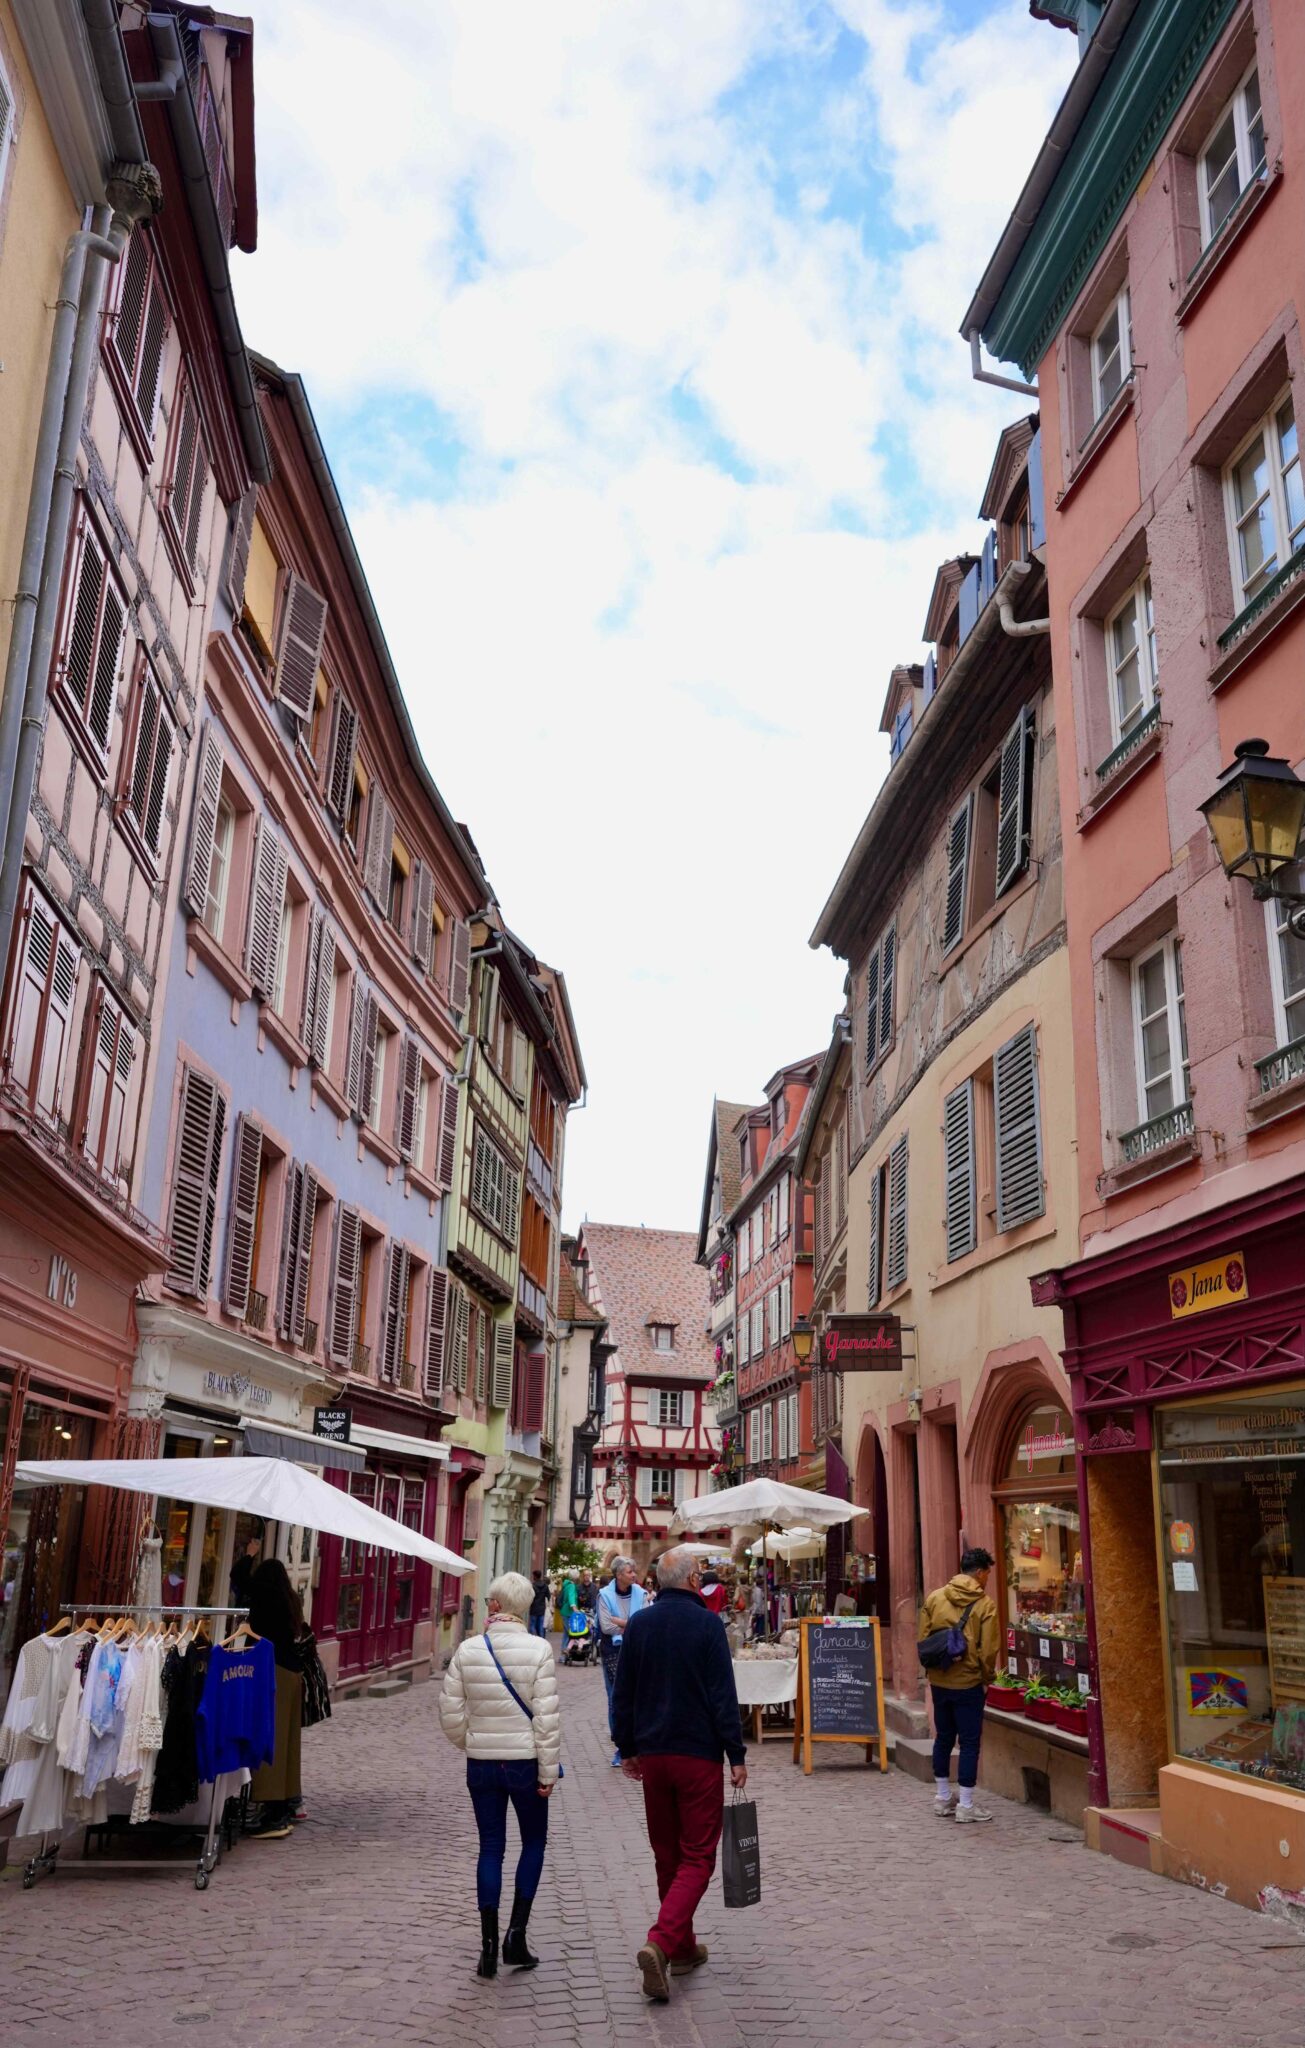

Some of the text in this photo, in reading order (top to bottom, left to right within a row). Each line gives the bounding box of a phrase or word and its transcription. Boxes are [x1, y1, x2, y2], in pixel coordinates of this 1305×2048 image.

[1189, 1271, 1223, 1306] Jana
[249, 1384, 273, 1405] LEGEND
[318, 1411, 346, 1420] BLACKS
[1275, 1438, 1299, 1457] Inde
[222, 1665, 255, 1682] AMOUR
[739, 1836, 757, 1848] VINUM
